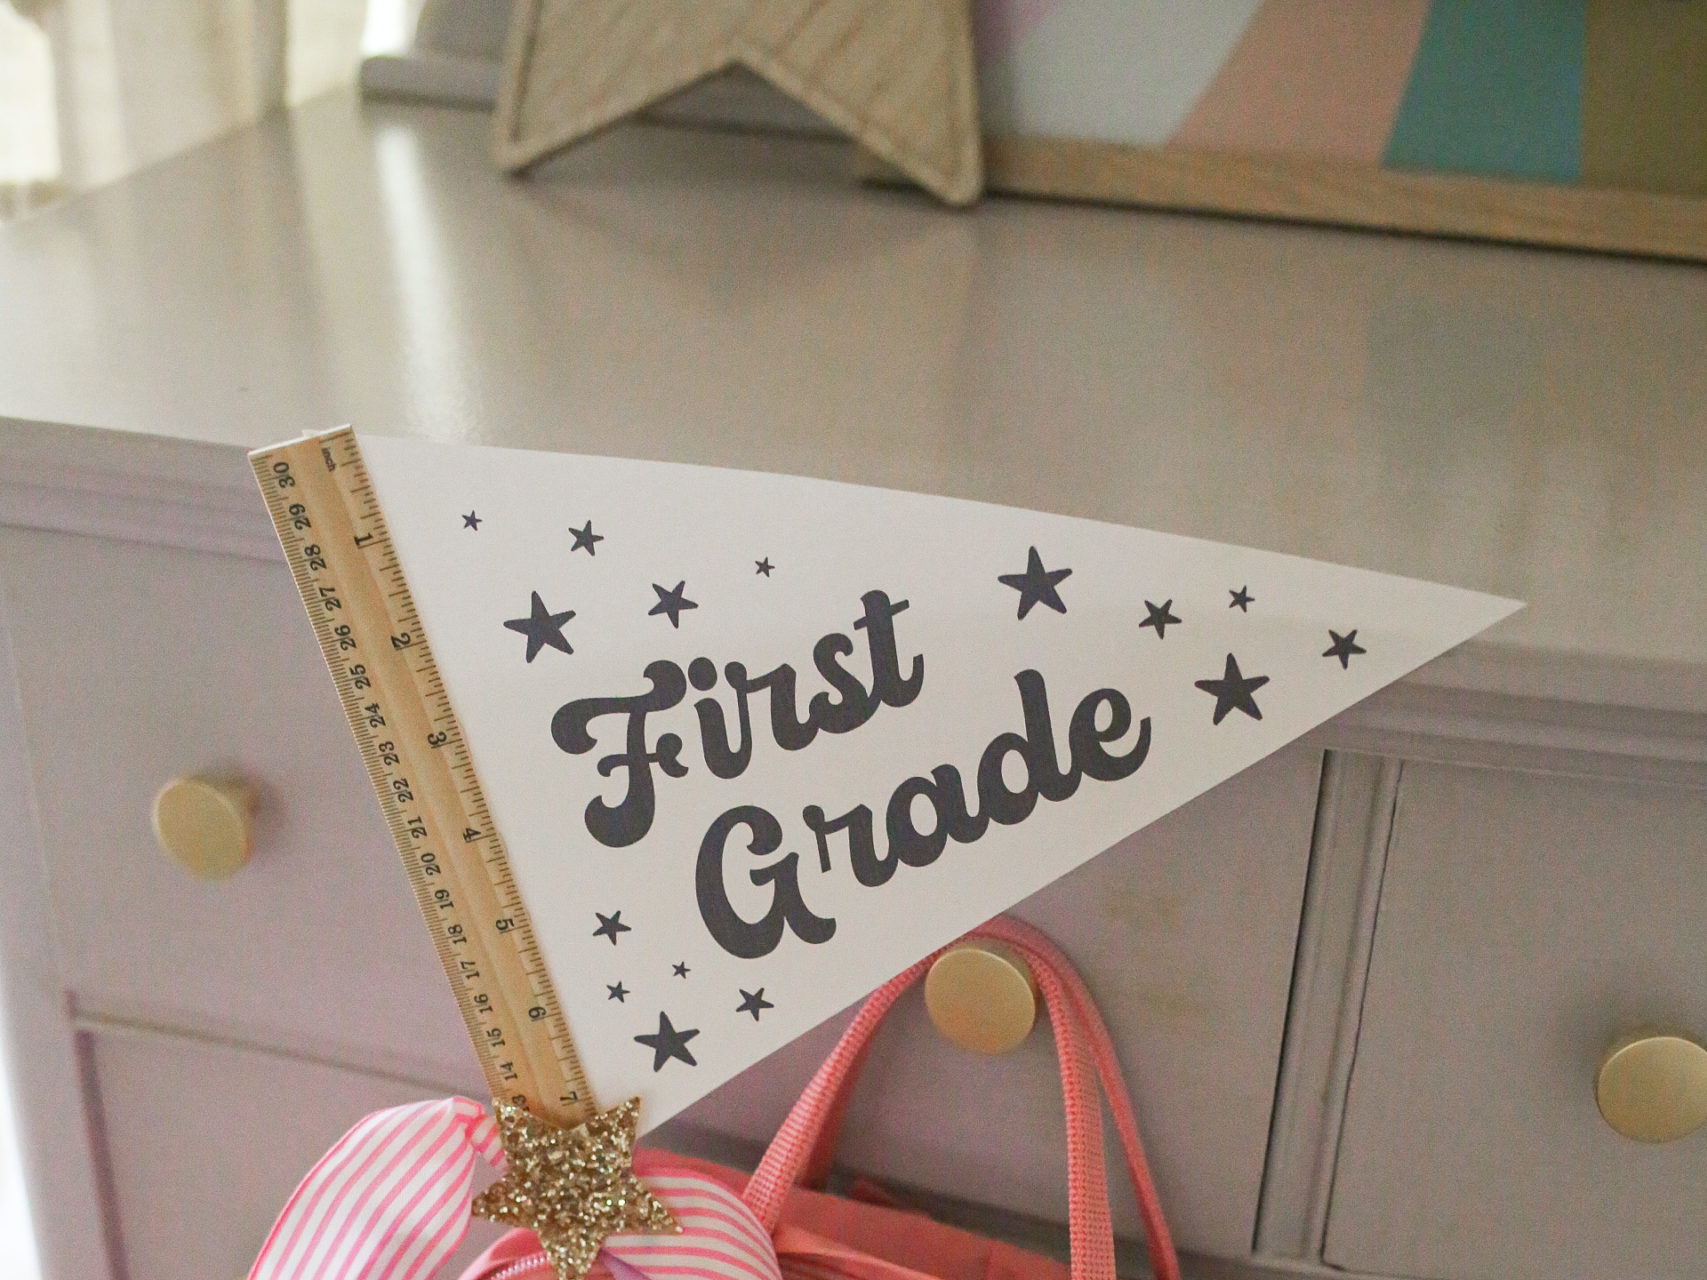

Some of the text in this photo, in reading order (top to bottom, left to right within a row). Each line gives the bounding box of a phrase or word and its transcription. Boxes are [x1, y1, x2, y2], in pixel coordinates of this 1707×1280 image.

[321, 447, 336, 473] inch
[273, 462, 296, 488] 30
[289, 503, 312, 530] 29
[354, 532, 374, 546] 1
[304, 544, 327, 571] 28
[319, 586, 342, 612] 27
[335, 624, 357, 651] 26
[391, 632, 411, 649] 2
[349, 664, 372, 690] 25
[365, 703, 386, 729] 24
[551, 590, 924, 848] First
[427, 731, 448, 746] 3
[379, 741, 400, 766] 23
[393, 778, 414, 803] 22
[695, 669, 1151, 959] Grade
[407, 816, 428, 839] 21
[463, 827, 482, 844] 4
[420, 852, 441, 876] 20
[434, 889, 454, 910] 19
[447, 924, 467, 945] 18
[495, 918, 515, 932] 5
[460, 960, 480, 980] 17
[474, 993, 494, 1014] 16
[528, 1006, 547, 1020] 6
[486, 1028, 506, 1048] 15
[500, 1062, 518, 1081] 14
[559, 1091, 578, 1103] 7
